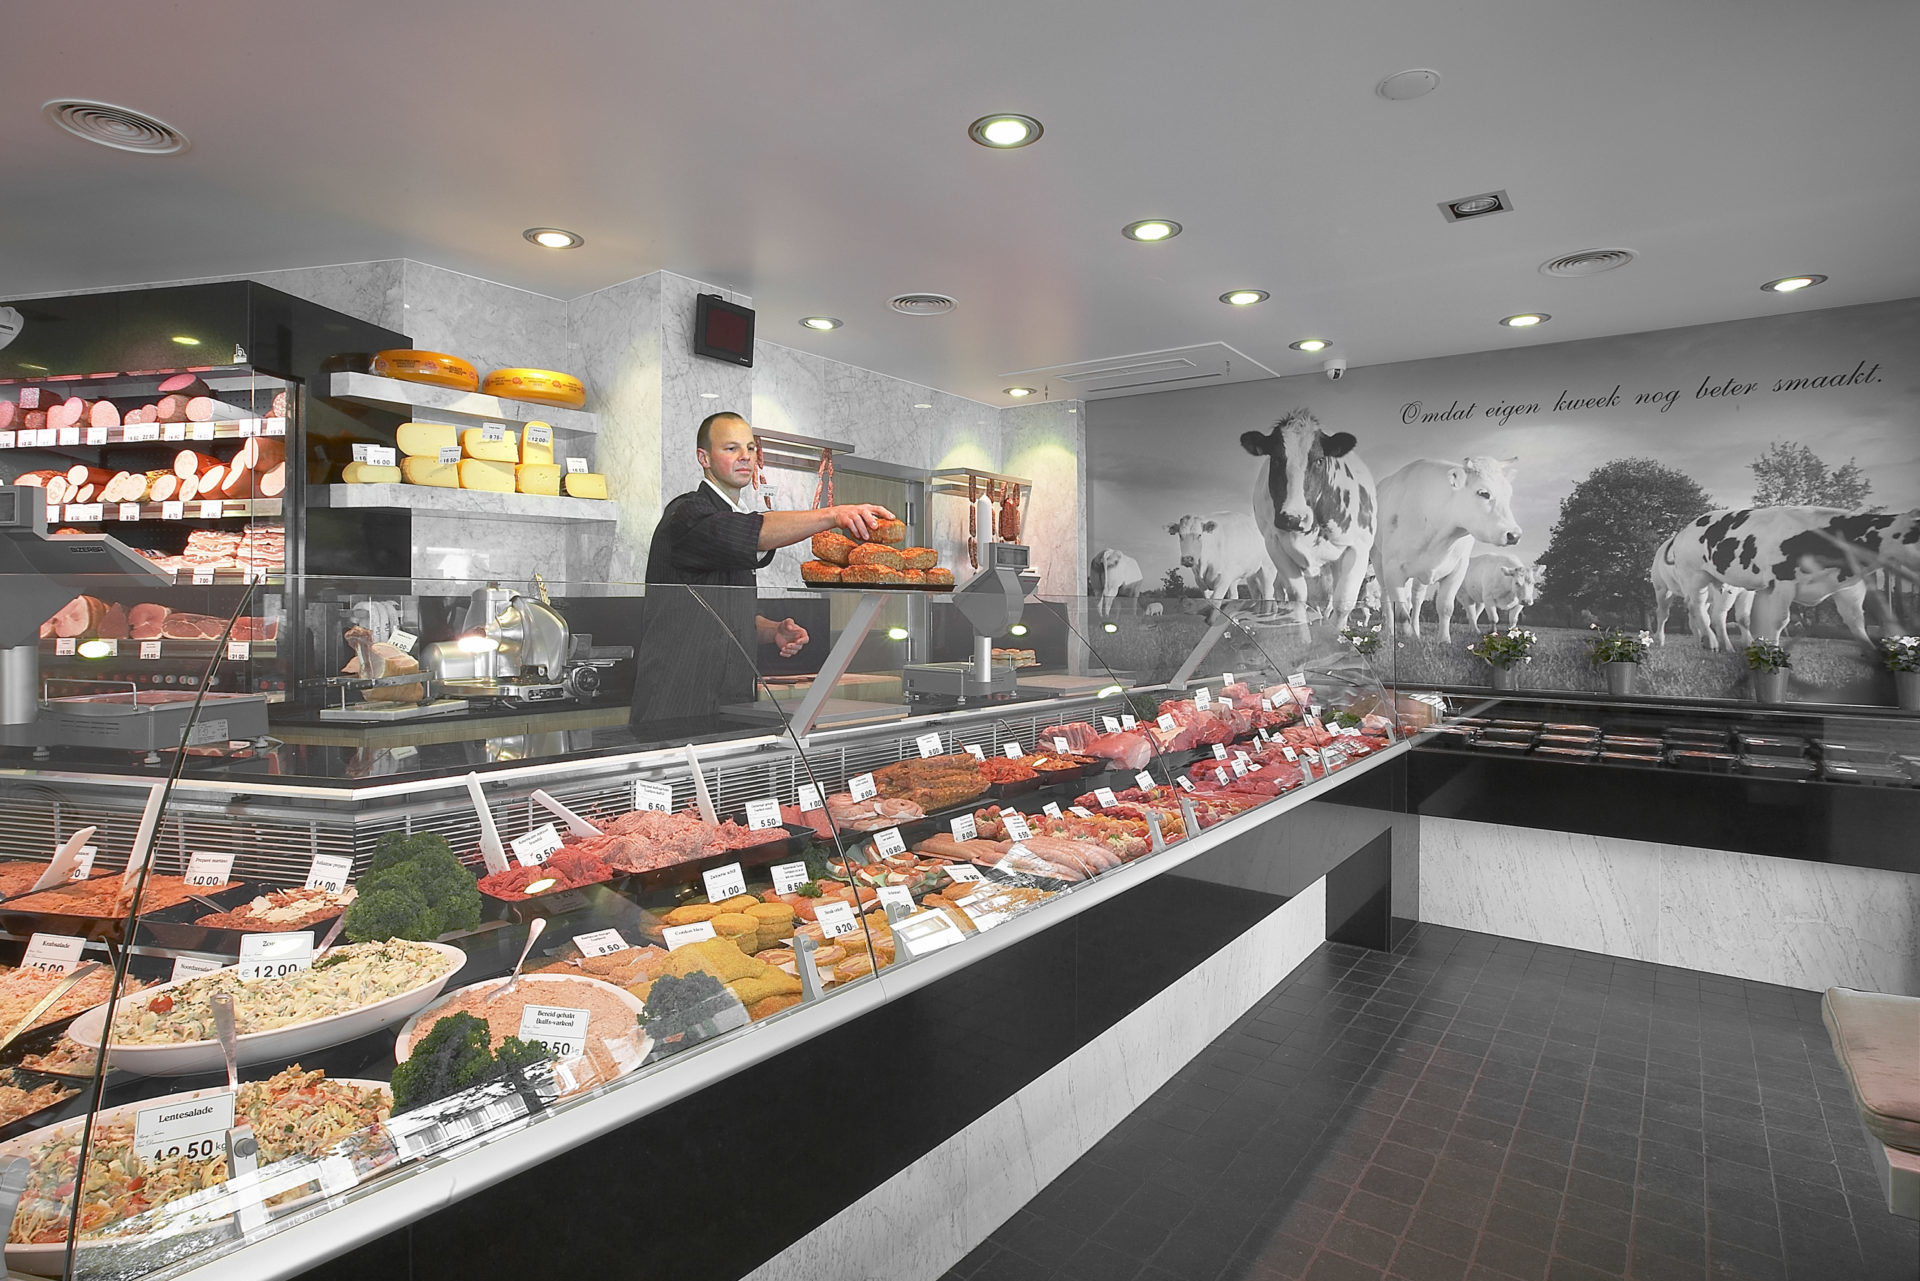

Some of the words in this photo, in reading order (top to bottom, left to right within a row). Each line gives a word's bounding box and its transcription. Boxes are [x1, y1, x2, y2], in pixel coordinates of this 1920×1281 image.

[1400, 400, 1477, 424] Omdat
[1485, 400, 1541, 426] eigen
[1553, 385, 1621, 412] kweek
[1634, 388, 1681, 413] nog
[1695, 375, 1758, 400] beter
[1772, 360, 1883, 392] smaakt.
[254, 963, 297, 979] 12.00
[158, 1106, 214, 1124] Lentesalade
